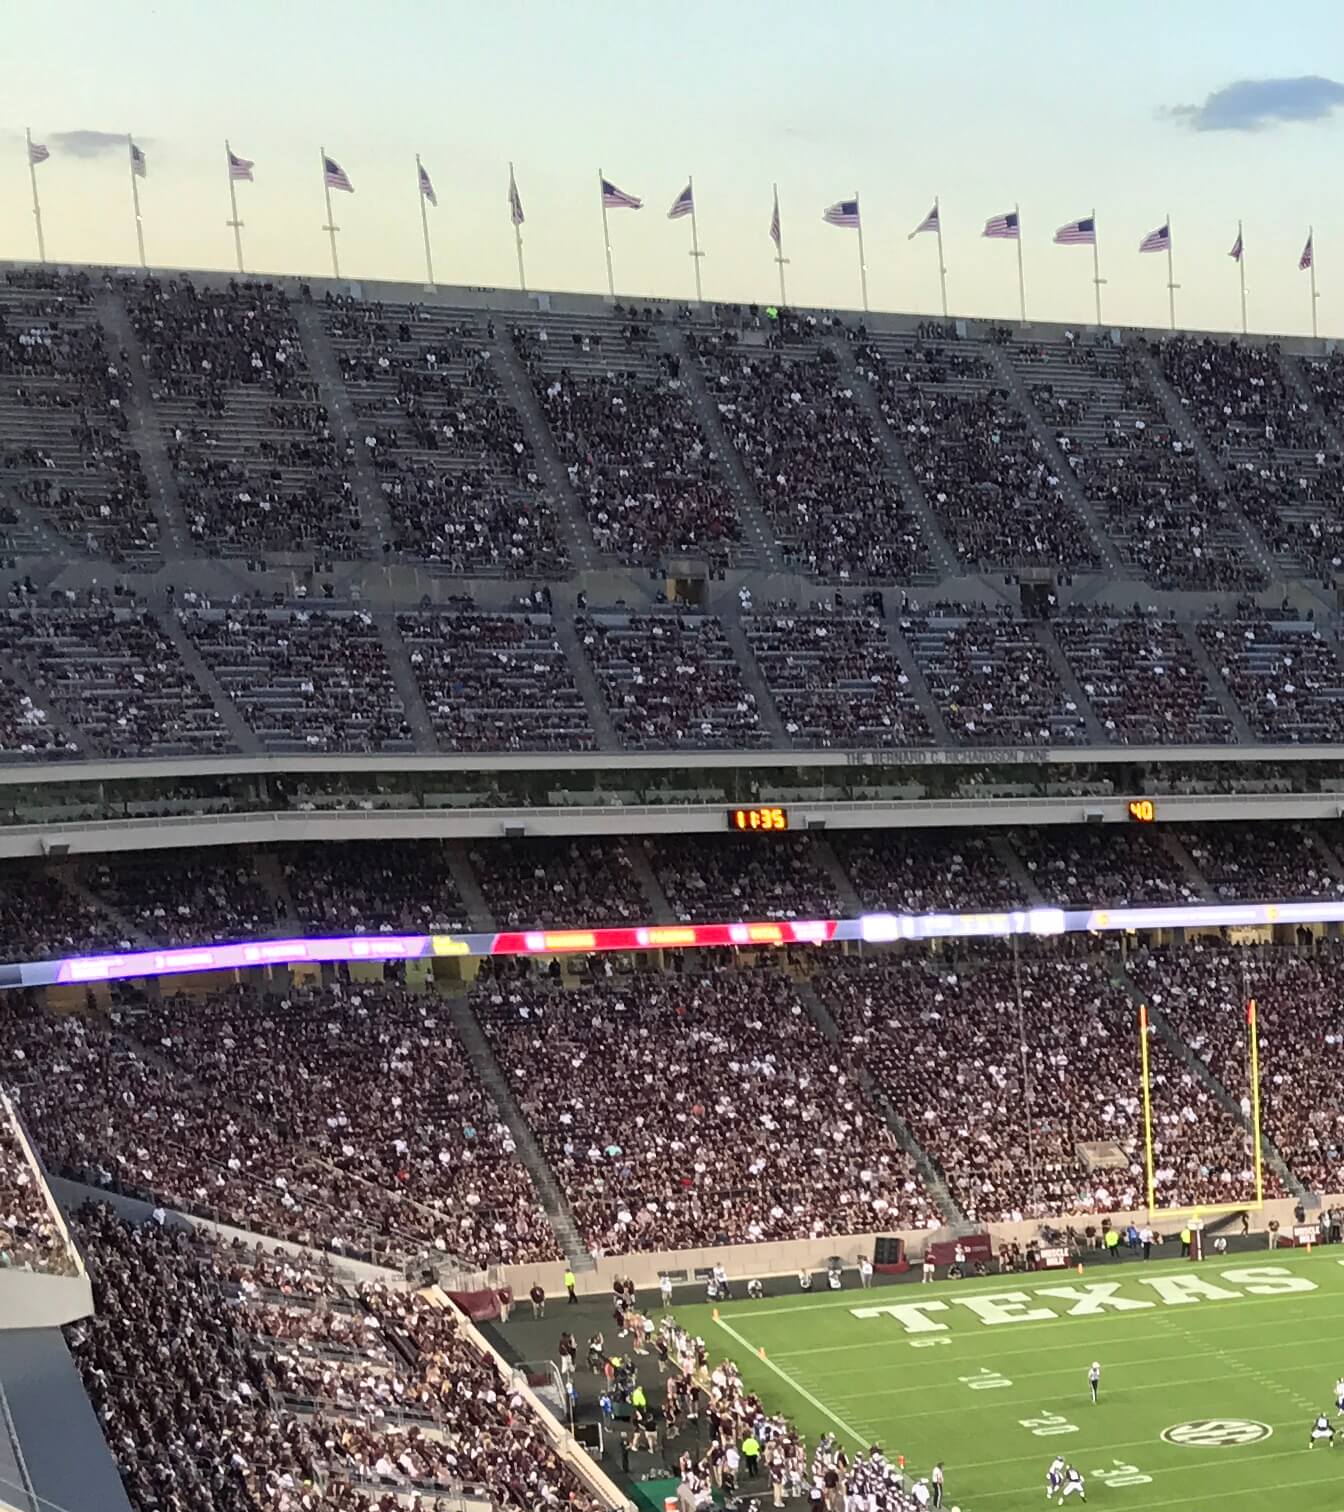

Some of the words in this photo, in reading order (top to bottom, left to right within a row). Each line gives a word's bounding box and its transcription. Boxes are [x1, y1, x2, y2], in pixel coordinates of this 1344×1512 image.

[736, 808, 785, 829] 11:35
[850, 1266, 1319, 1333] TEXAS
[959, 1372, 1012, 1390] 10
[1017, 1416, 1079, 1436] 20
[1086, 1465, 1153, 1488] 30
